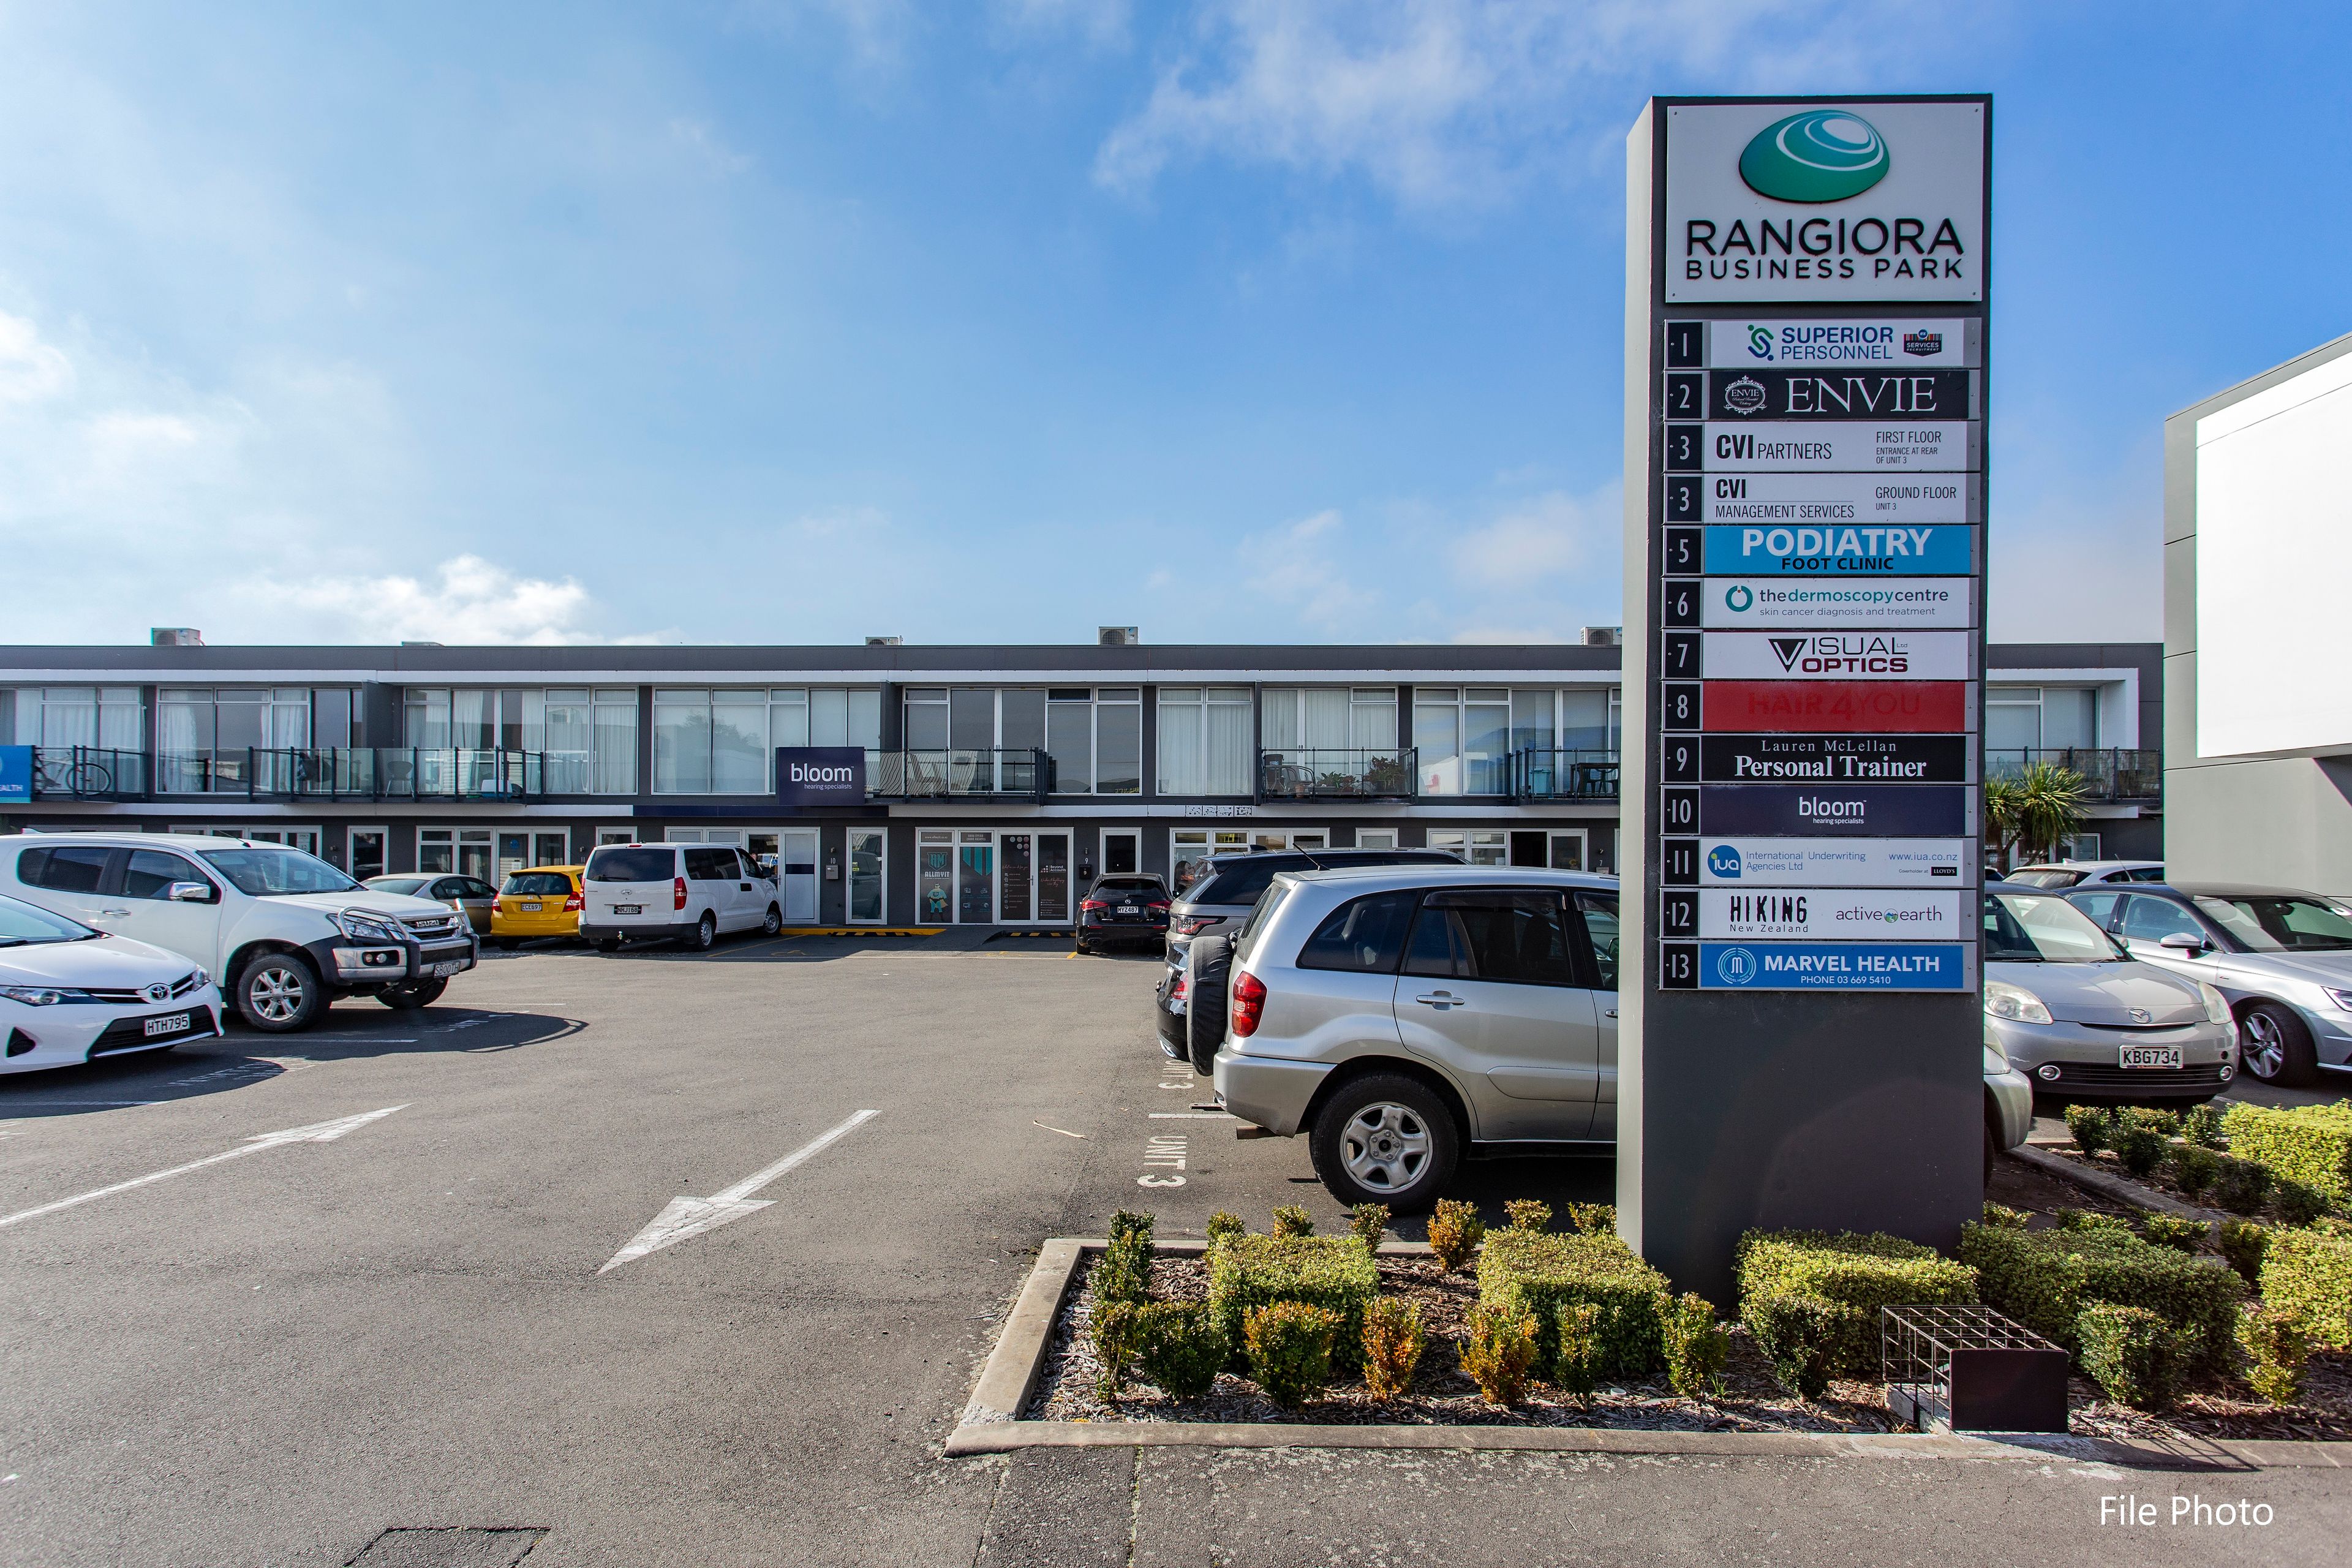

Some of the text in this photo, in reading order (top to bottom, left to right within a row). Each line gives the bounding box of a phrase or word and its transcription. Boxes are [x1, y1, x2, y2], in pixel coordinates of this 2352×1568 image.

[1686, 218, 1965, 256] RANGIORA
[1686, 258, 1963, 280] BUSINESS PARK
[1681, 333, 1689, 357] 1
[1782, 326, 1893, 344] SUPERIOR
[1782, 345, 1893, 360] PERSONNEL
[1679, 384, 1691, 409] 2
[1785, 377, 1937, 412] ENVIE
[1679, 435, 1690, 459] 3
[1716, 434, 1832, 460] CVI PARTNERS
[1876, 431, 1941, 444] FIRST FLOOR
[1876, 447, 1939, 456] ENTRANCE AT REAR
[1876, 456, 1885, 465] OF
[1716, 478, 1747, 499] CVI
[1875, 486, 1957, 499] GROUND FLOOR
[1679, 488, 1689, 511] 3
[1716, 505, 1855, 519] MANAGEMENT SERVICES
[1679, 540, 1689, 564] 5
[1743, 529, 1933, 557] PODIATRY
[1781, 558, 1894, 570] FOOT CLINIC
[1678, 592, 1688, 616] 6
[1760, 589, 1949, 605] thedermoscopycentre
[1760, 607, 1780, 616] skin
[1817, 608, 1863, 617] diagnosis
[1678, 644, 1688, 668] 7
[1801, 657, 1909, 673] OPTICS
[1678, 695, 1688, 719] 8
[1747, 692, 1823, 715] HAIR
[1853, 692, 1921, 715] YOU
[1762, 740, 1897, 752] Lauren McLellan
[1677, 747, 1687, 771] 9
[1734, 755, 1927, 777] Personal Trainer
[791, 763, 852, 782] bloom
[1672, 799, 1691, 823] 10
[1799, 796, 1864, 816] bloom
[1674, 850, 1689, 875] 11
[1713, 857, 1740, 871] iua
[1746, 851, 1866, 862] International Underwriting
[1746, 861, 1803, 872] Agencies Ltd
[1888, 852, 1958, 861] www.iua.co.nz
[1671, 902, 1690, 926] 12
[1730, 895, 1807, 924] HIKING
[1836, 906, 1942, 921] active earth
[1730, 924, 1809, 933] New Zealand
[1670, 954, 1689, 979] 13
[1765, 956, 1940, 972] MARVEL HEALTH
[147, 1016, 189, 1033] HTH795
[2123, 1050, 2179, 1064] KBG734
[1161, 1060, 1194, 1079] UNIT
[1137, 1136, 1188, 1188] UNIT 3
